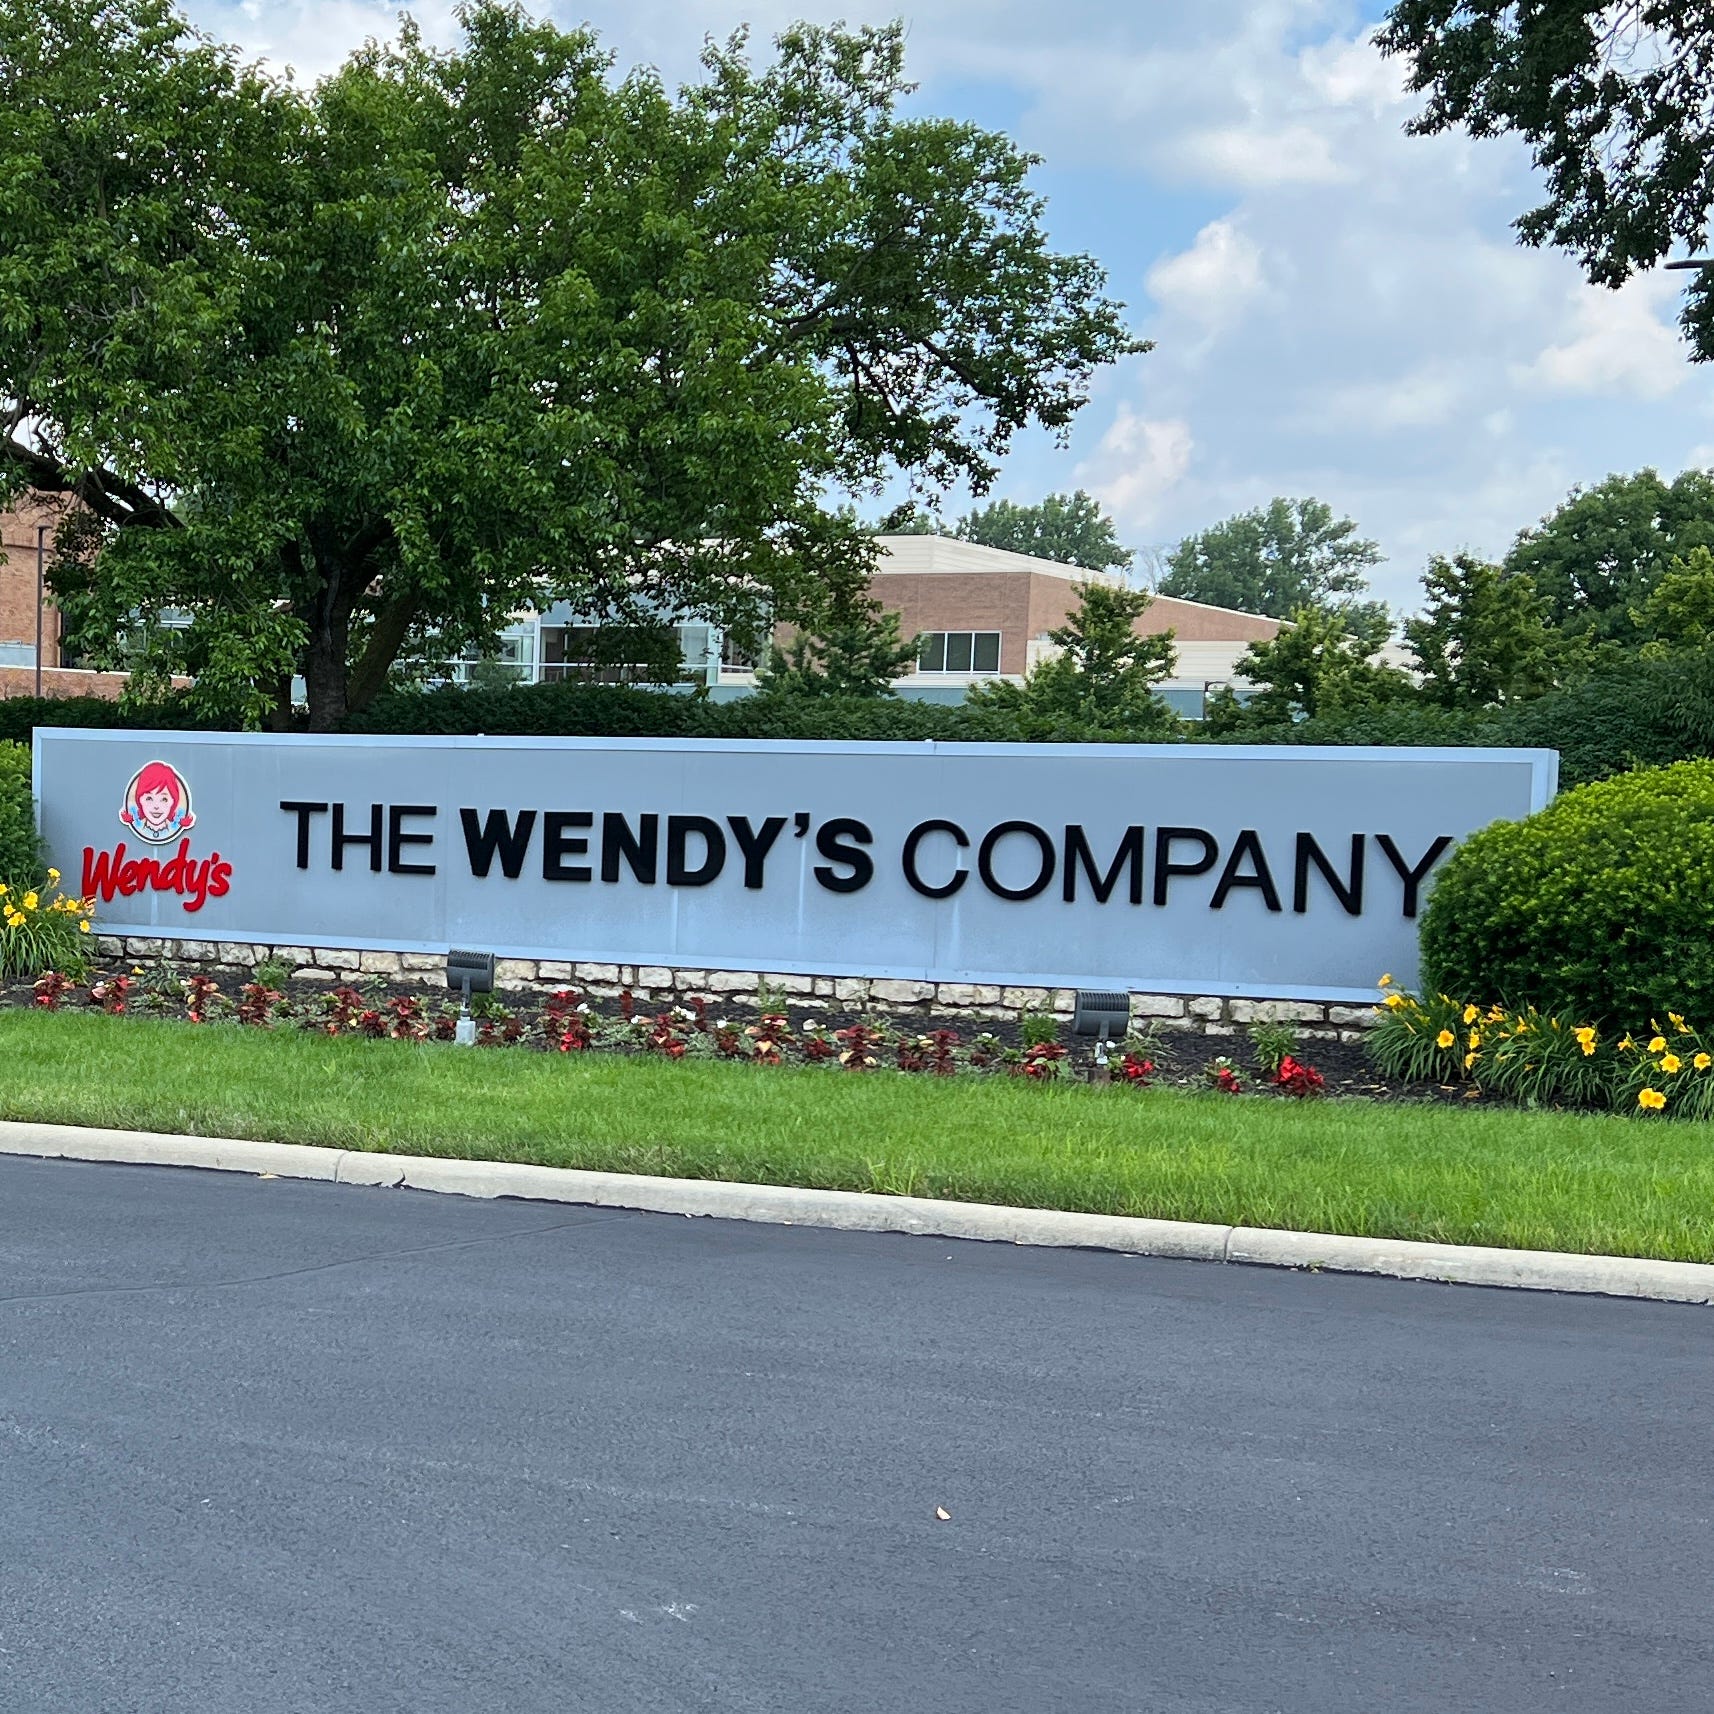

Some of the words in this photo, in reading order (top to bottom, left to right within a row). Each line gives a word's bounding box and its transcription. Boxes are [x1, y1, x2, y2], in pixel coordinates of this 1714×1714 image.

[82, 837, 233, 913] Wendy's
[279, 800, 437, 876] THE
[459, 808, 875, 894] WENDY'S
[902, 818, 1454, 919] COMPANY
